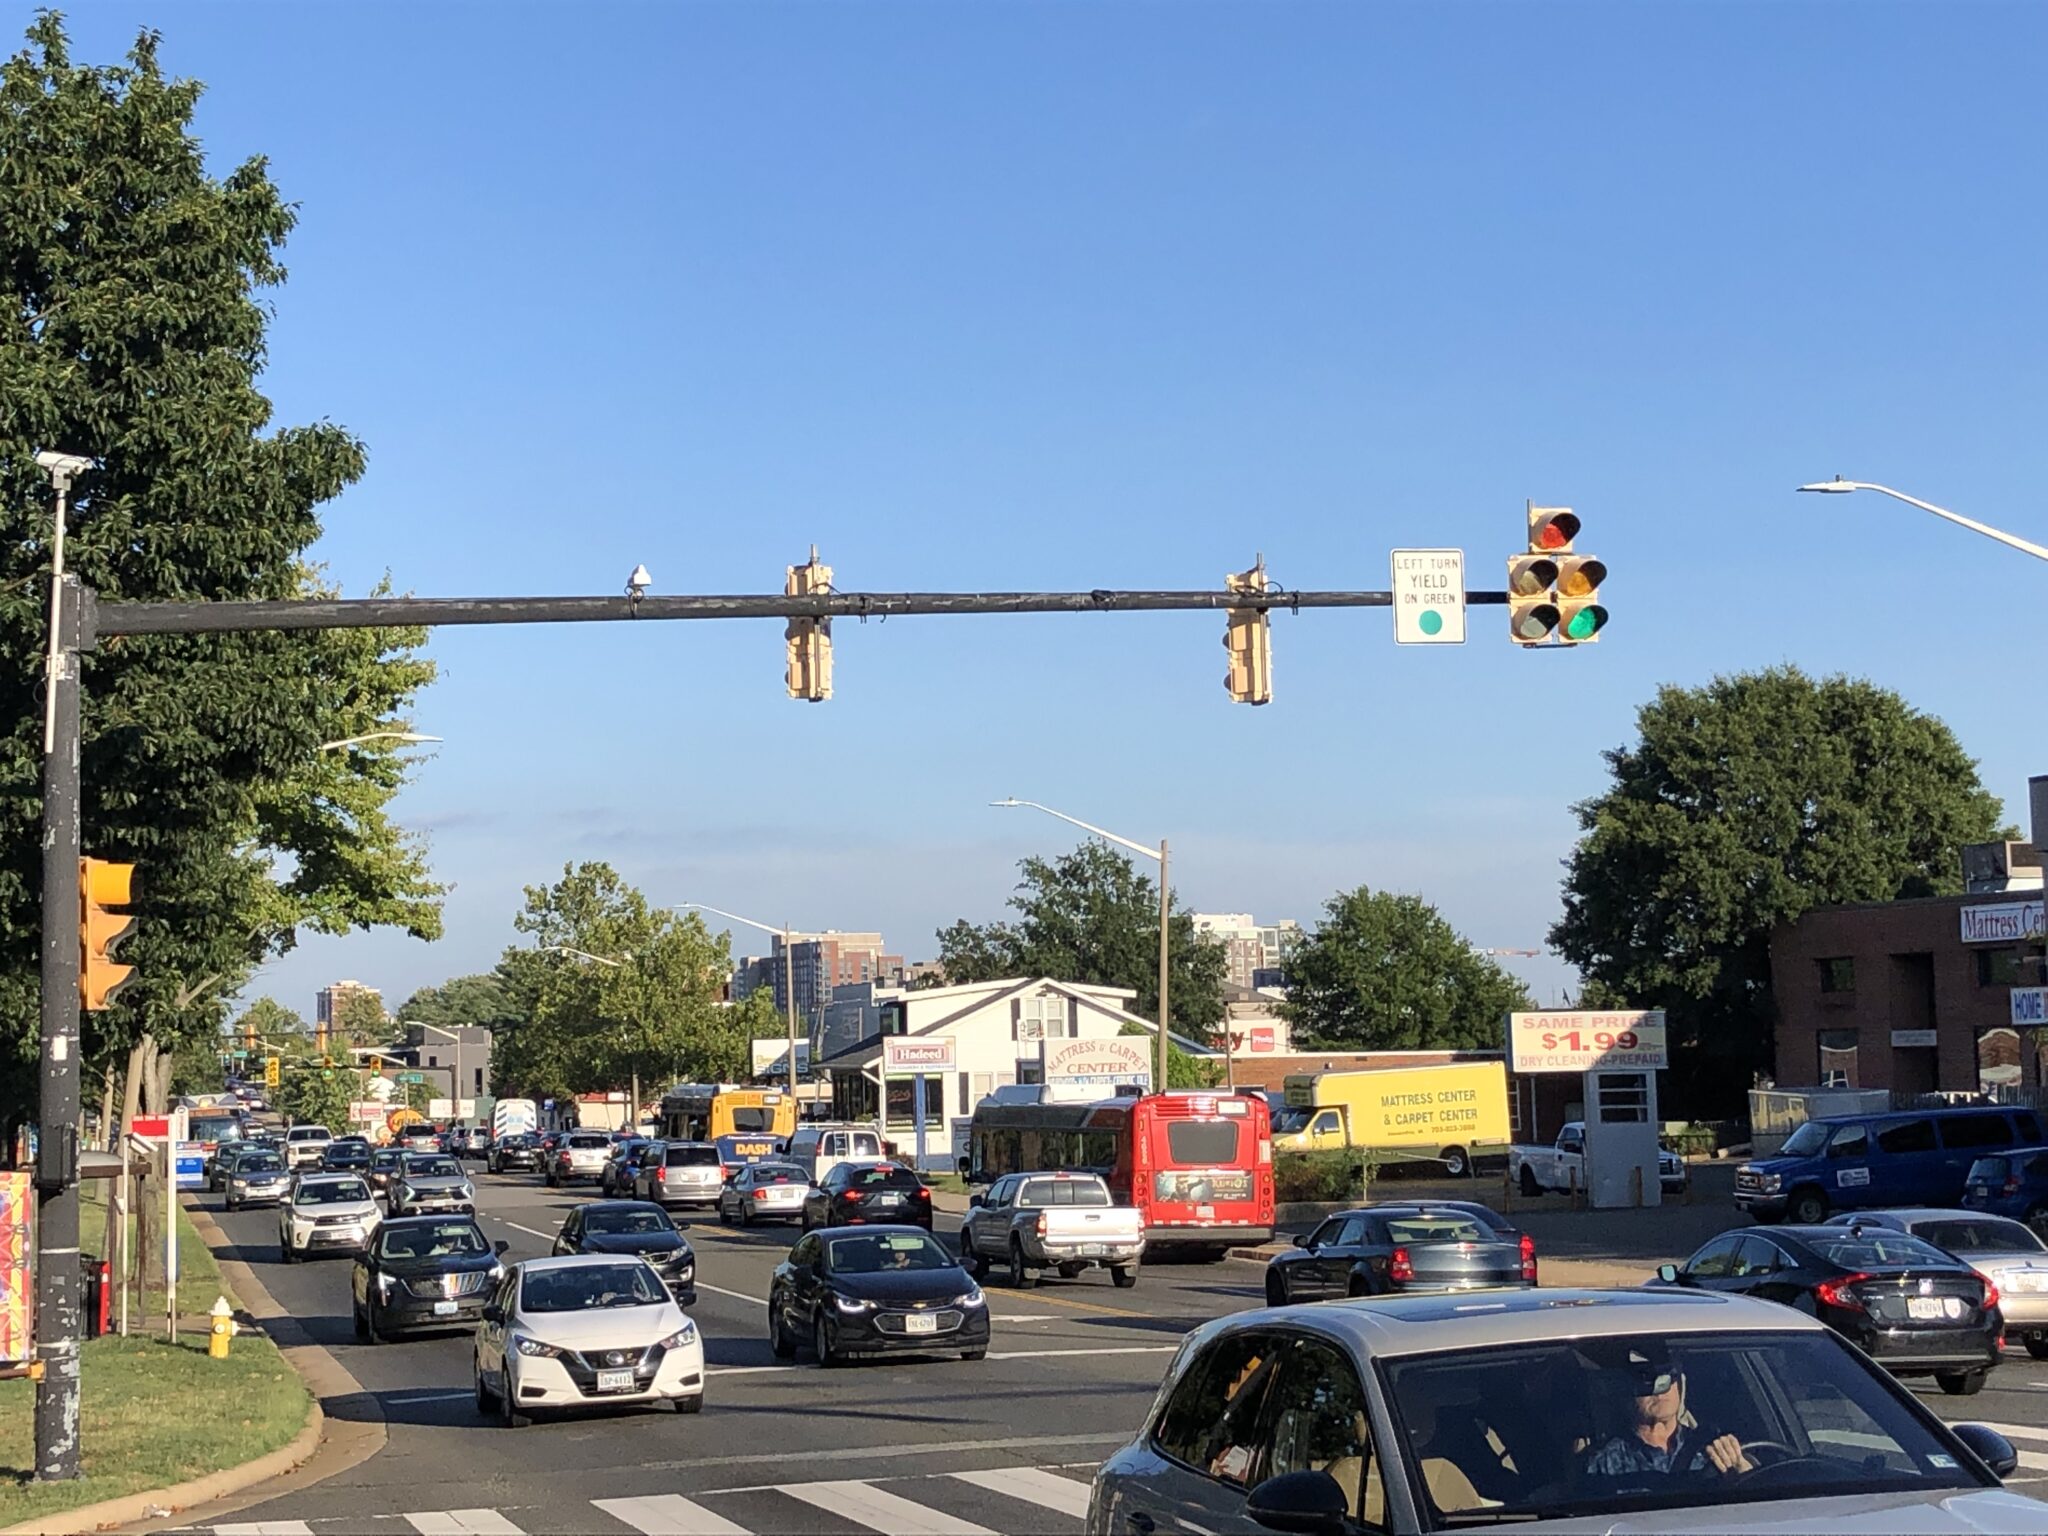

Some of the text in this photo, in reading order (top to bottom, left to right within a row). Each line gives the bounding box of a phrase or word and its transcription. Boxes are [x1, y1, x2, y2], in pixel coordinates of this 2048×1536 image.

[1396, 558, 1459, 569] LEFT TURN
[1410, 574, 1448, 588] YIELD
[1404, 593, 1456, 604] ON GREEN
[1964, 909, 2018, 938] Mattress
[2014, 991, 2042, 1020] HOME
[1522, 1015, 1657, 1029] SAME PRICE
[1541, 1031, 1638, 1051] $1.99
[900, 1048, 942, 1060] Hadeed
[1047, 1040, 1096, 1074] MATTRESS
[1109, 1042, 1148, 1071] CARPET
[1066, 1062, 1128, 1074] CENTER
[1520, 1056, 1543, 1067] DRY
[1381, 1089, 1477, 1107] MATTRESS CENTER
[1383, 1108, 1478, 1125] & CARPET CENTER
[735, 1143, 773, 1155] DASH
